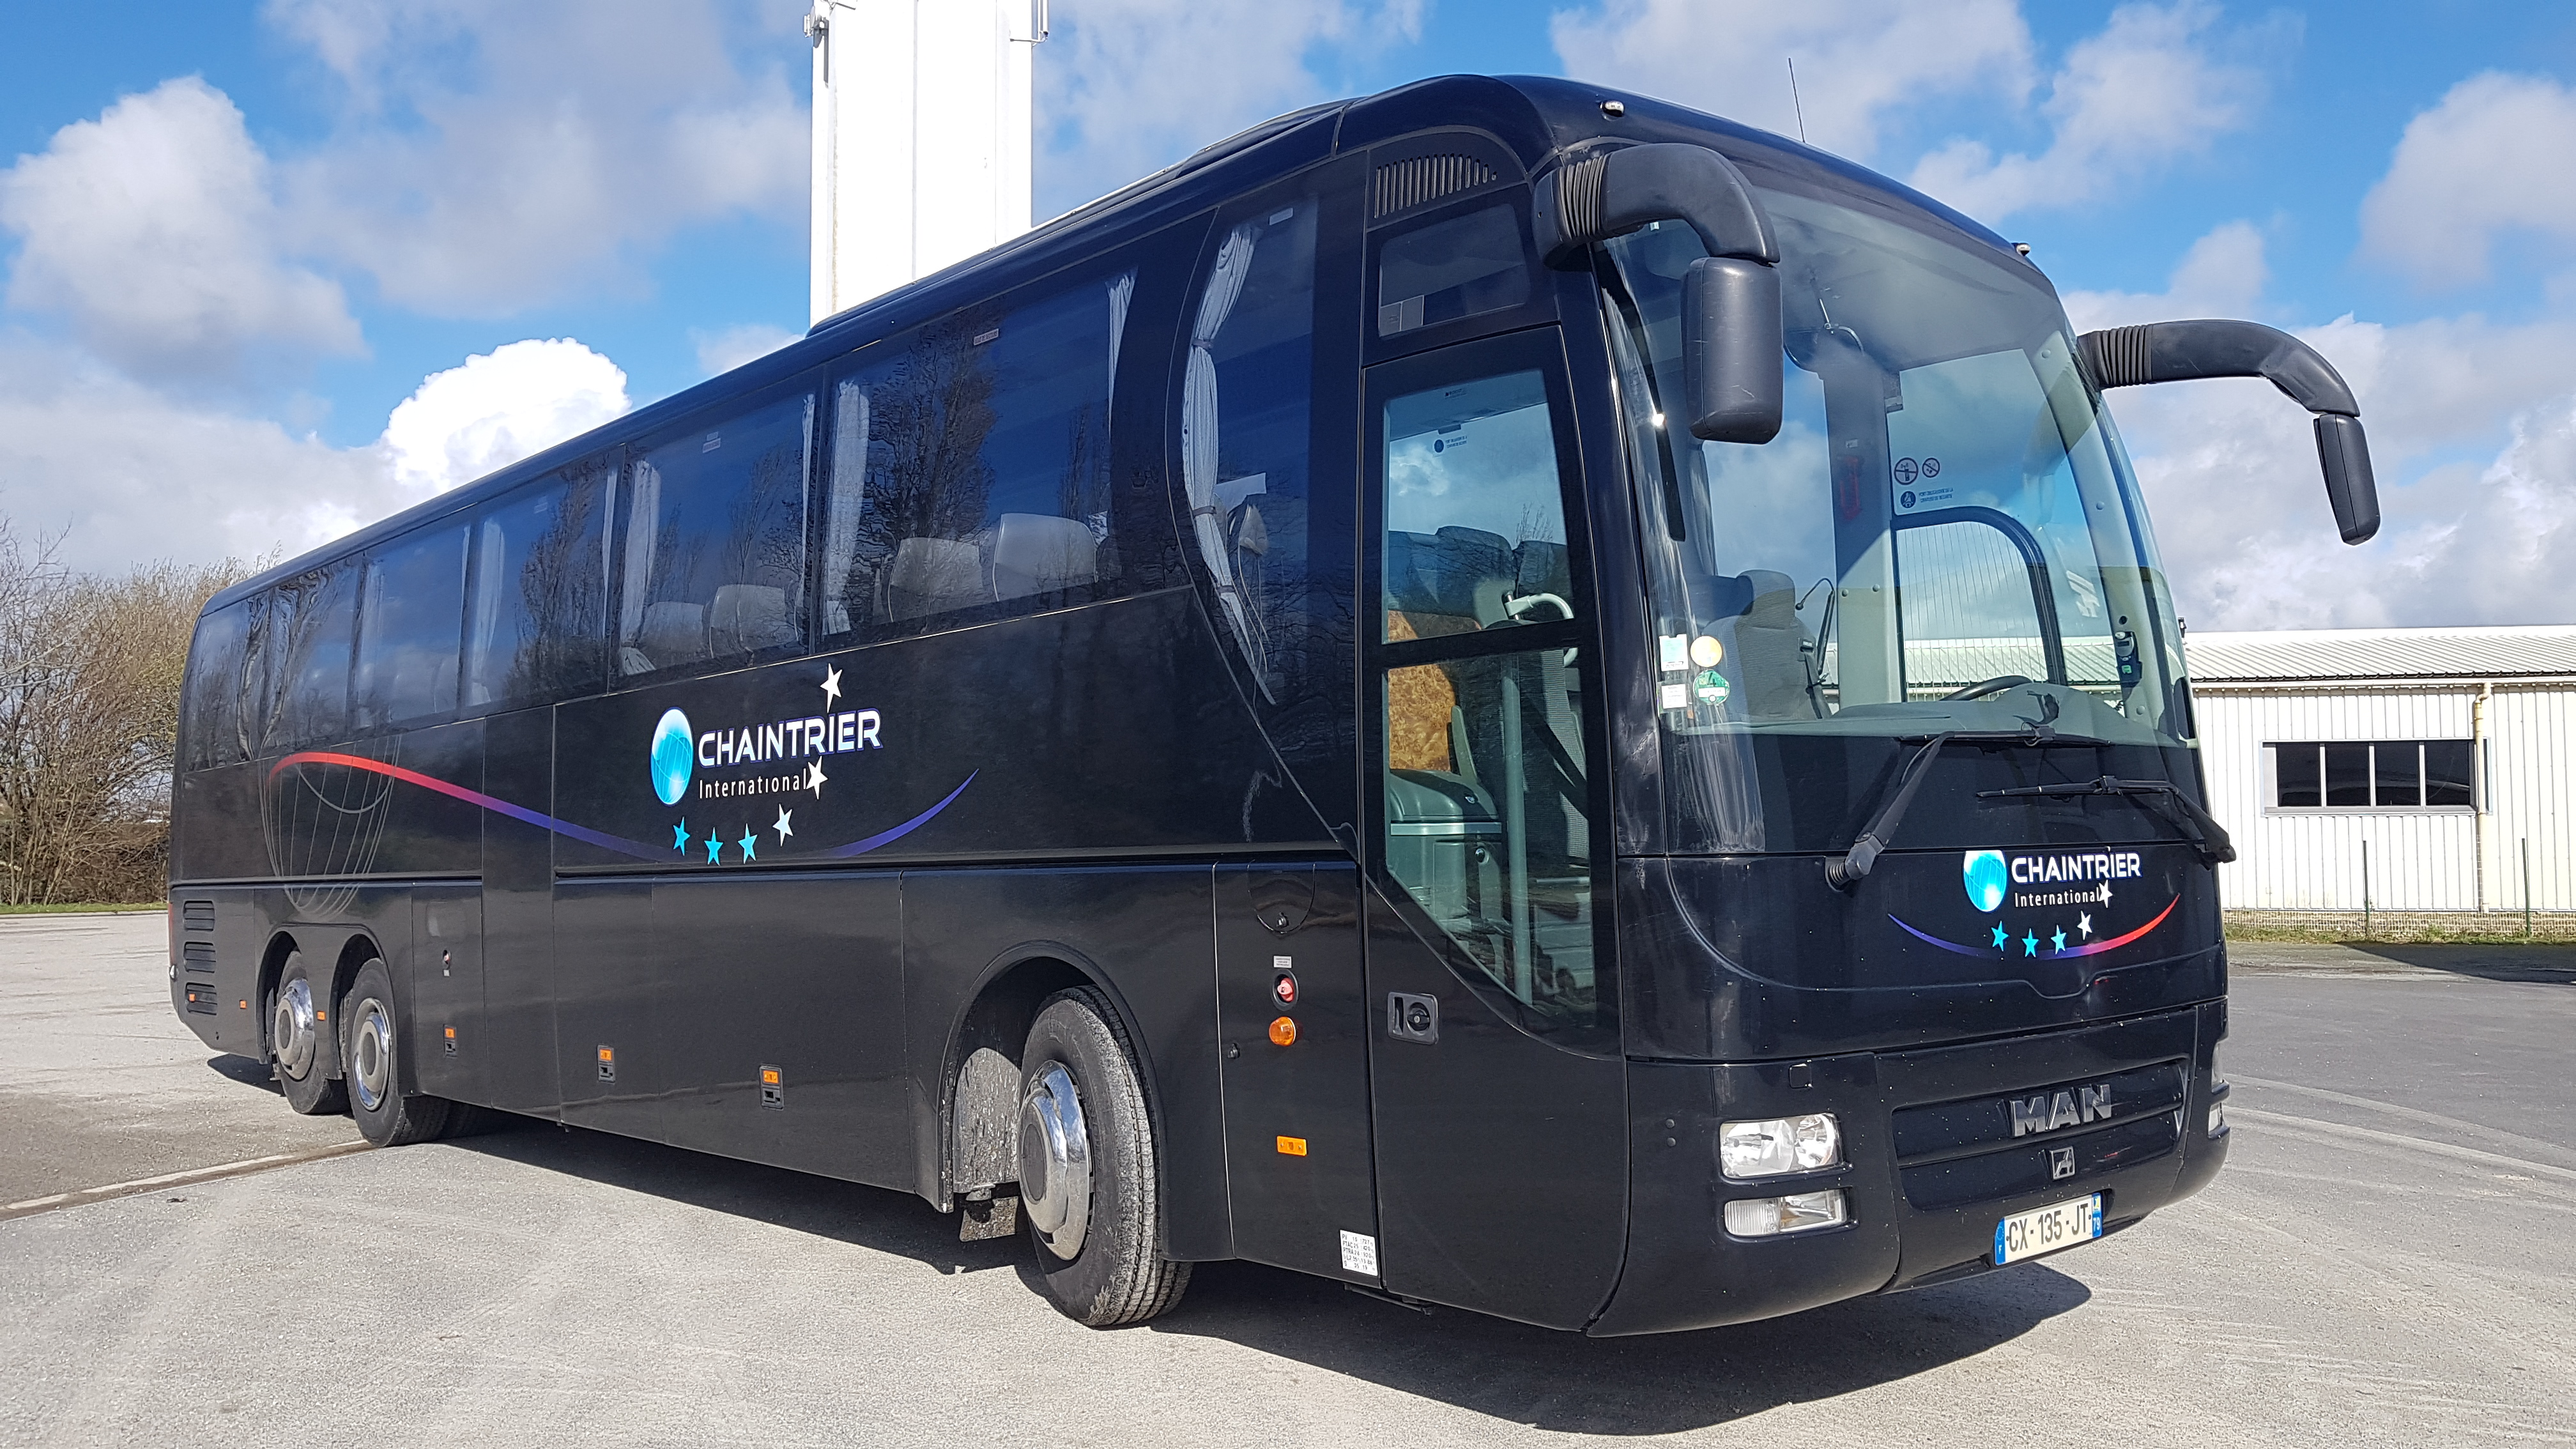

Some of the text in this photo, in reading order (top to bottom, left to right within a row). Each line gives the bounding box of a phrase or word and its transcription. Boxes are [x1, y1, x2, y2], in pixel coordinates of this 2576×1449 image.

[698, 709, 883, 767] CHAINTRIER
[700, 768, 807, 799] International
[2011, 852, 2142, 884] CHAINTRIER
[2014, 887, 2099, 907] International
[2010, 1084, 2112, 1137] MAN
[2093, 1216, 2101, 1232] 79
[1998, 1245, 2002, 1255] F
